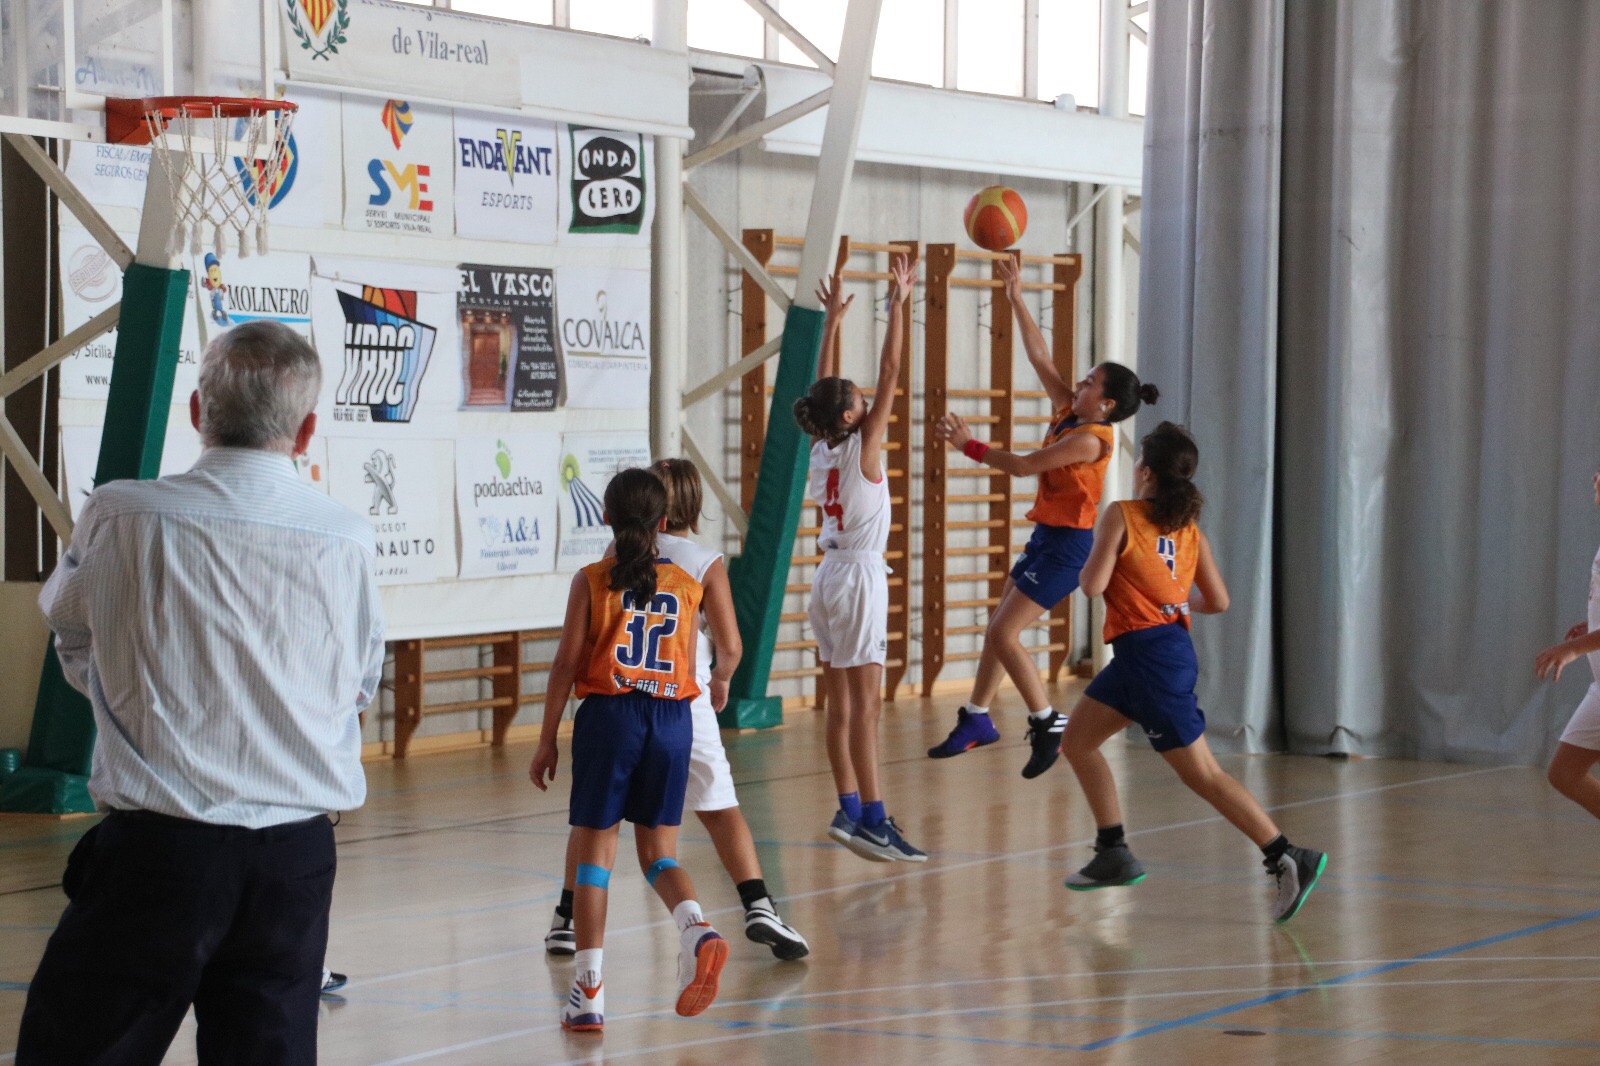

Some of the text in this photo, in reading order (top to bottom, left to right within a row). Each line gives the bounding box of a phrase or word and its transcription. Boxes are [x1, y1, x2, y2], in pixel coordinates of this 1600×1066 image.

[392, 27, 489, 66] de Vila-real
[458, 129, 552, 187] ENDAVANT
[581, 149, 633, 169] ONDA
[367, 158, 434, 212] SME
[588, 187, 634, 208] CERO
[481, 192, 534, 210] ESPORTS
[459, 269, 552, 298] EL VASCO
[227, 284, 309, 315] MOLINERO
[474, 476, 543, 508] podoactiva
[375, 522, 407, 533] UGEOT
[503, 516, 541, 544] A&A
[376, 538, 435, 557] NAUTO
[614, 588, 680, 674] 32
